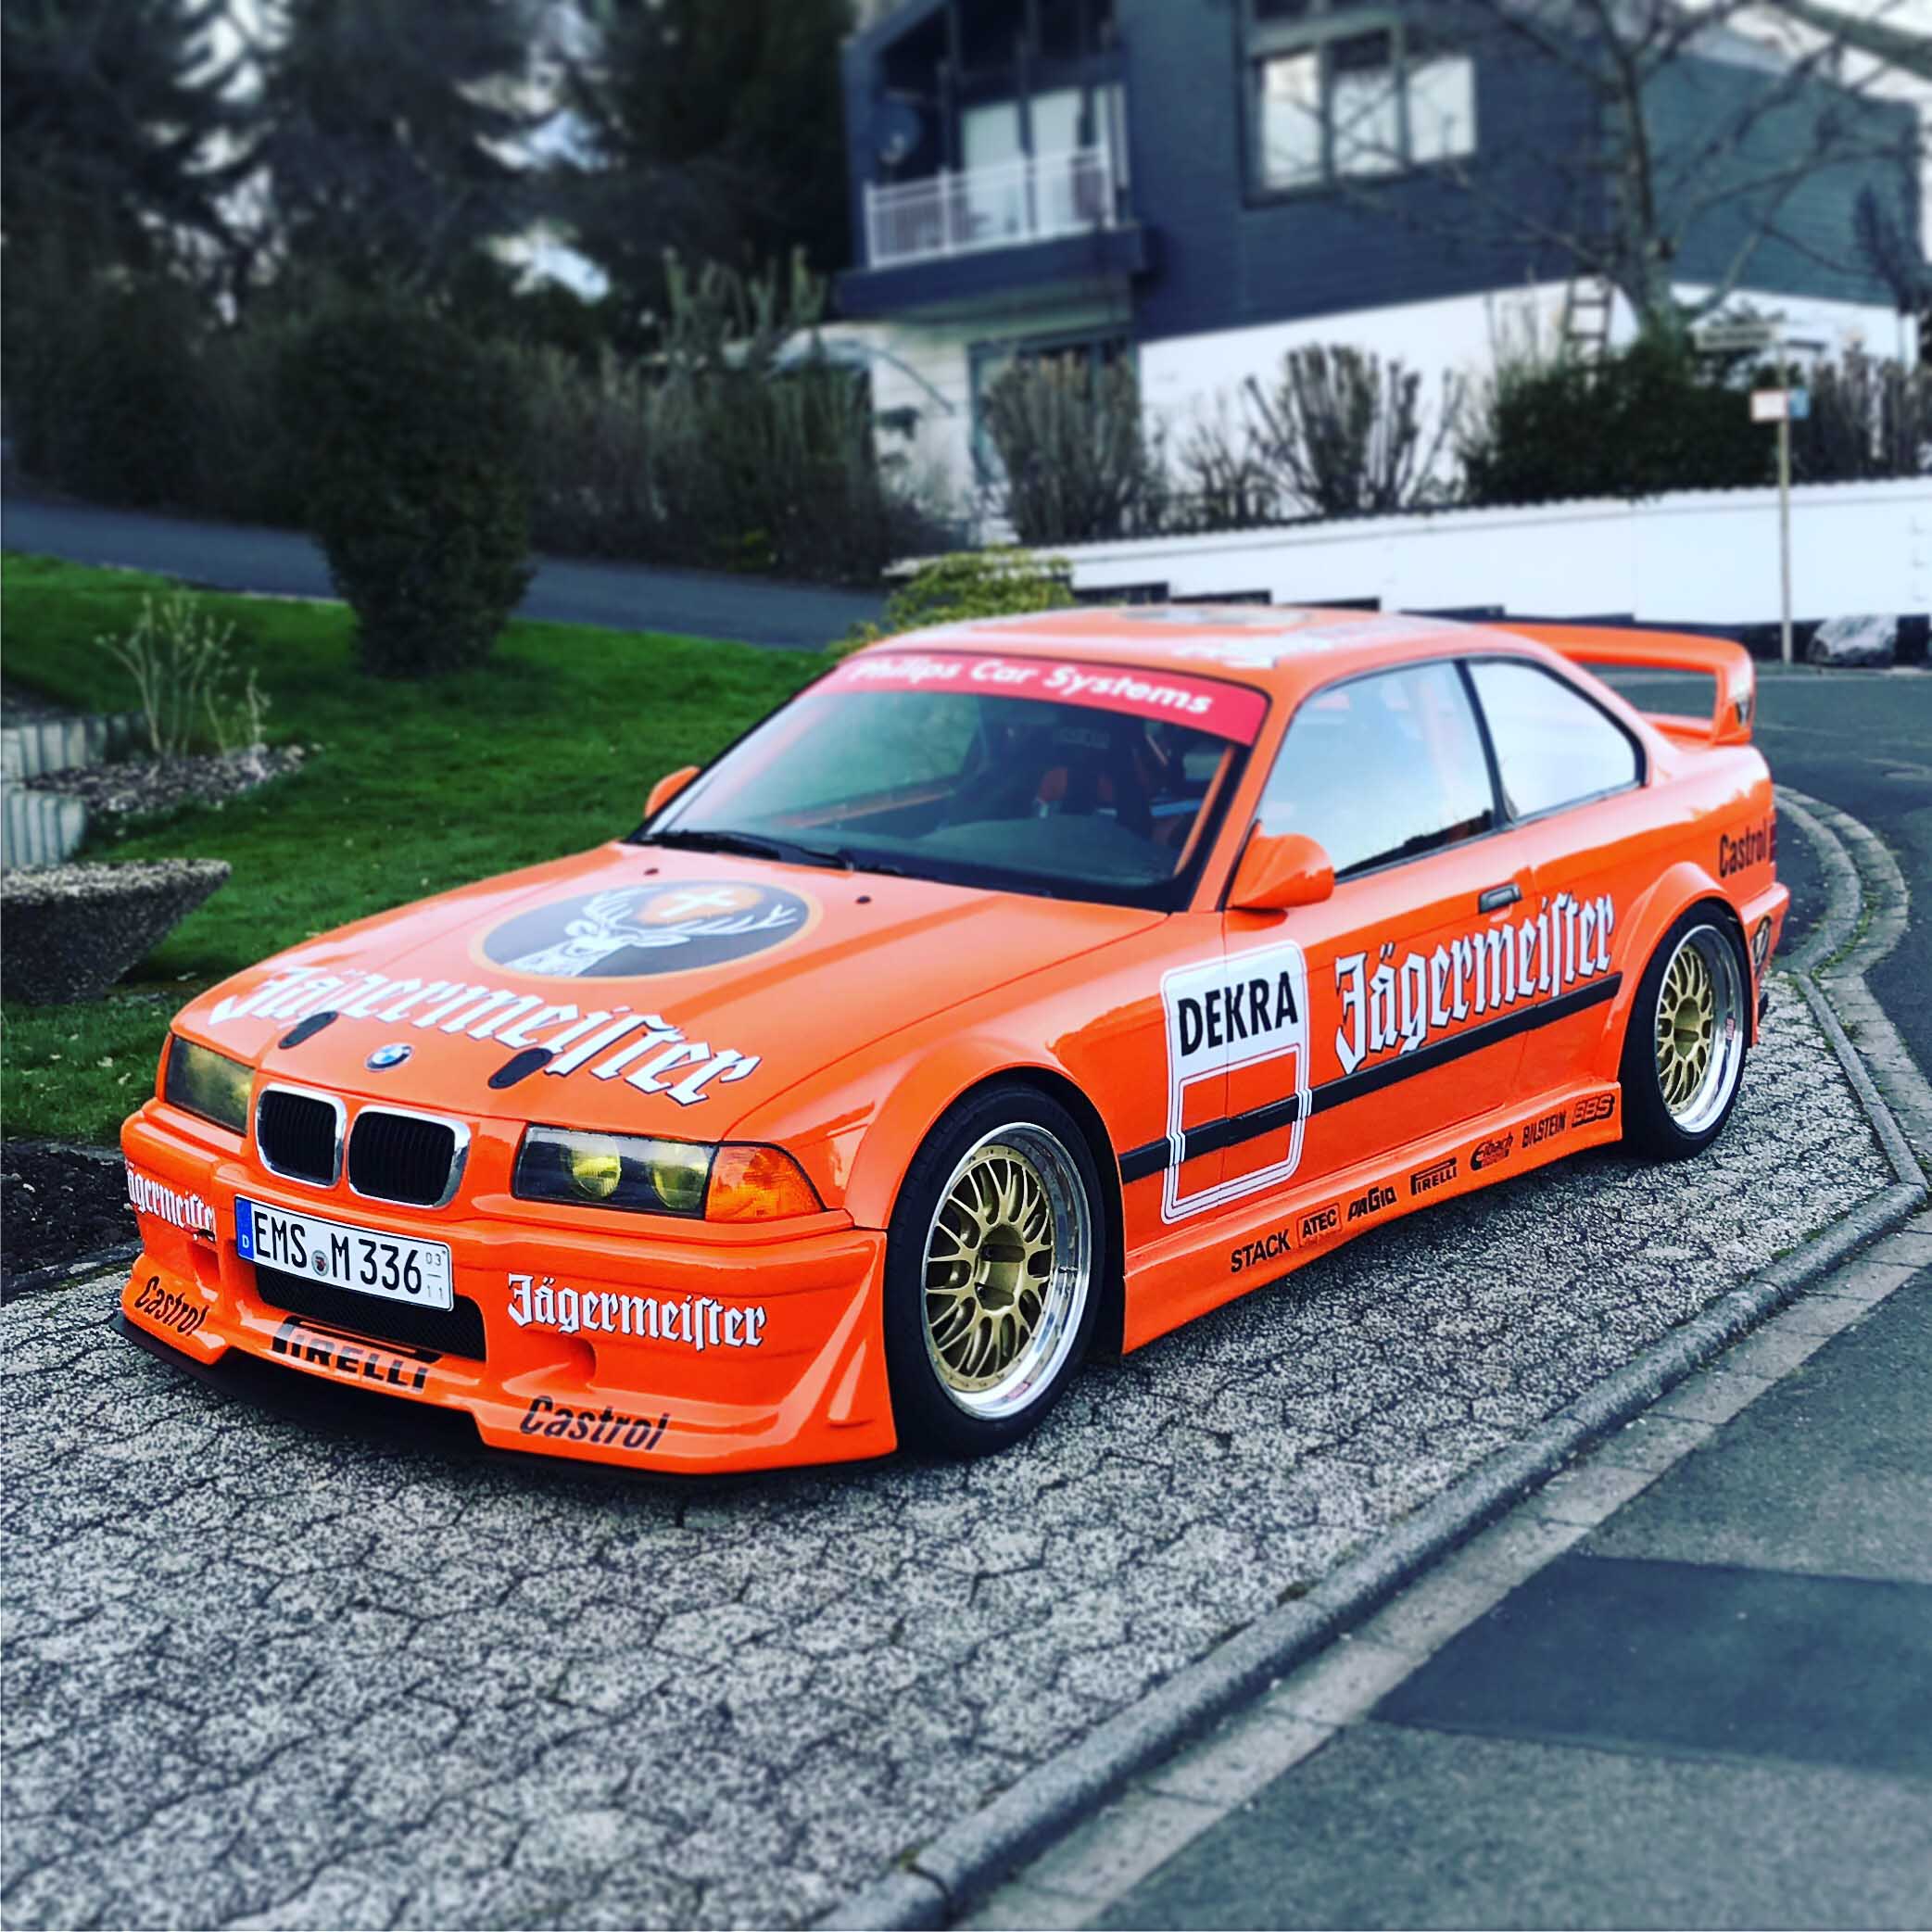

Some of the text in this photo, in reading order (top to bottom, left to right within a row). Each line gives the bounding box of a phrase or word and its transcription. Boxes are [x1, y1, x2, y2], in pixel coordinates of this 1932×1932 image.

[970, 659, 1040, 684] Car
[1043, 665, 1212, 715] Systems
[1720, 818, 1767, 878] Castrol
[1178, 970, 1298, 1057] DEKRA
[1522, 1109, 1567, 1149] BILSTEIN
[1572, 1093, 1616, 1129] BBS
[1409, 1157, 1458, 1196] PIRELLI
[241, 1234, 249, 1249] D
[1301, 1207, 1338, 1239] ATEC
[254, 1210, 423, 1294] EMS M 336
[425, 1251, 442, 1266] 03
[1231, 1229, 1292, 1273] STACK
[133, 1275, 210, 1336] Castrol
[271, 1315, 443, 1391] PIRELLI
[520, 1395, 670, 1451] Castrol
